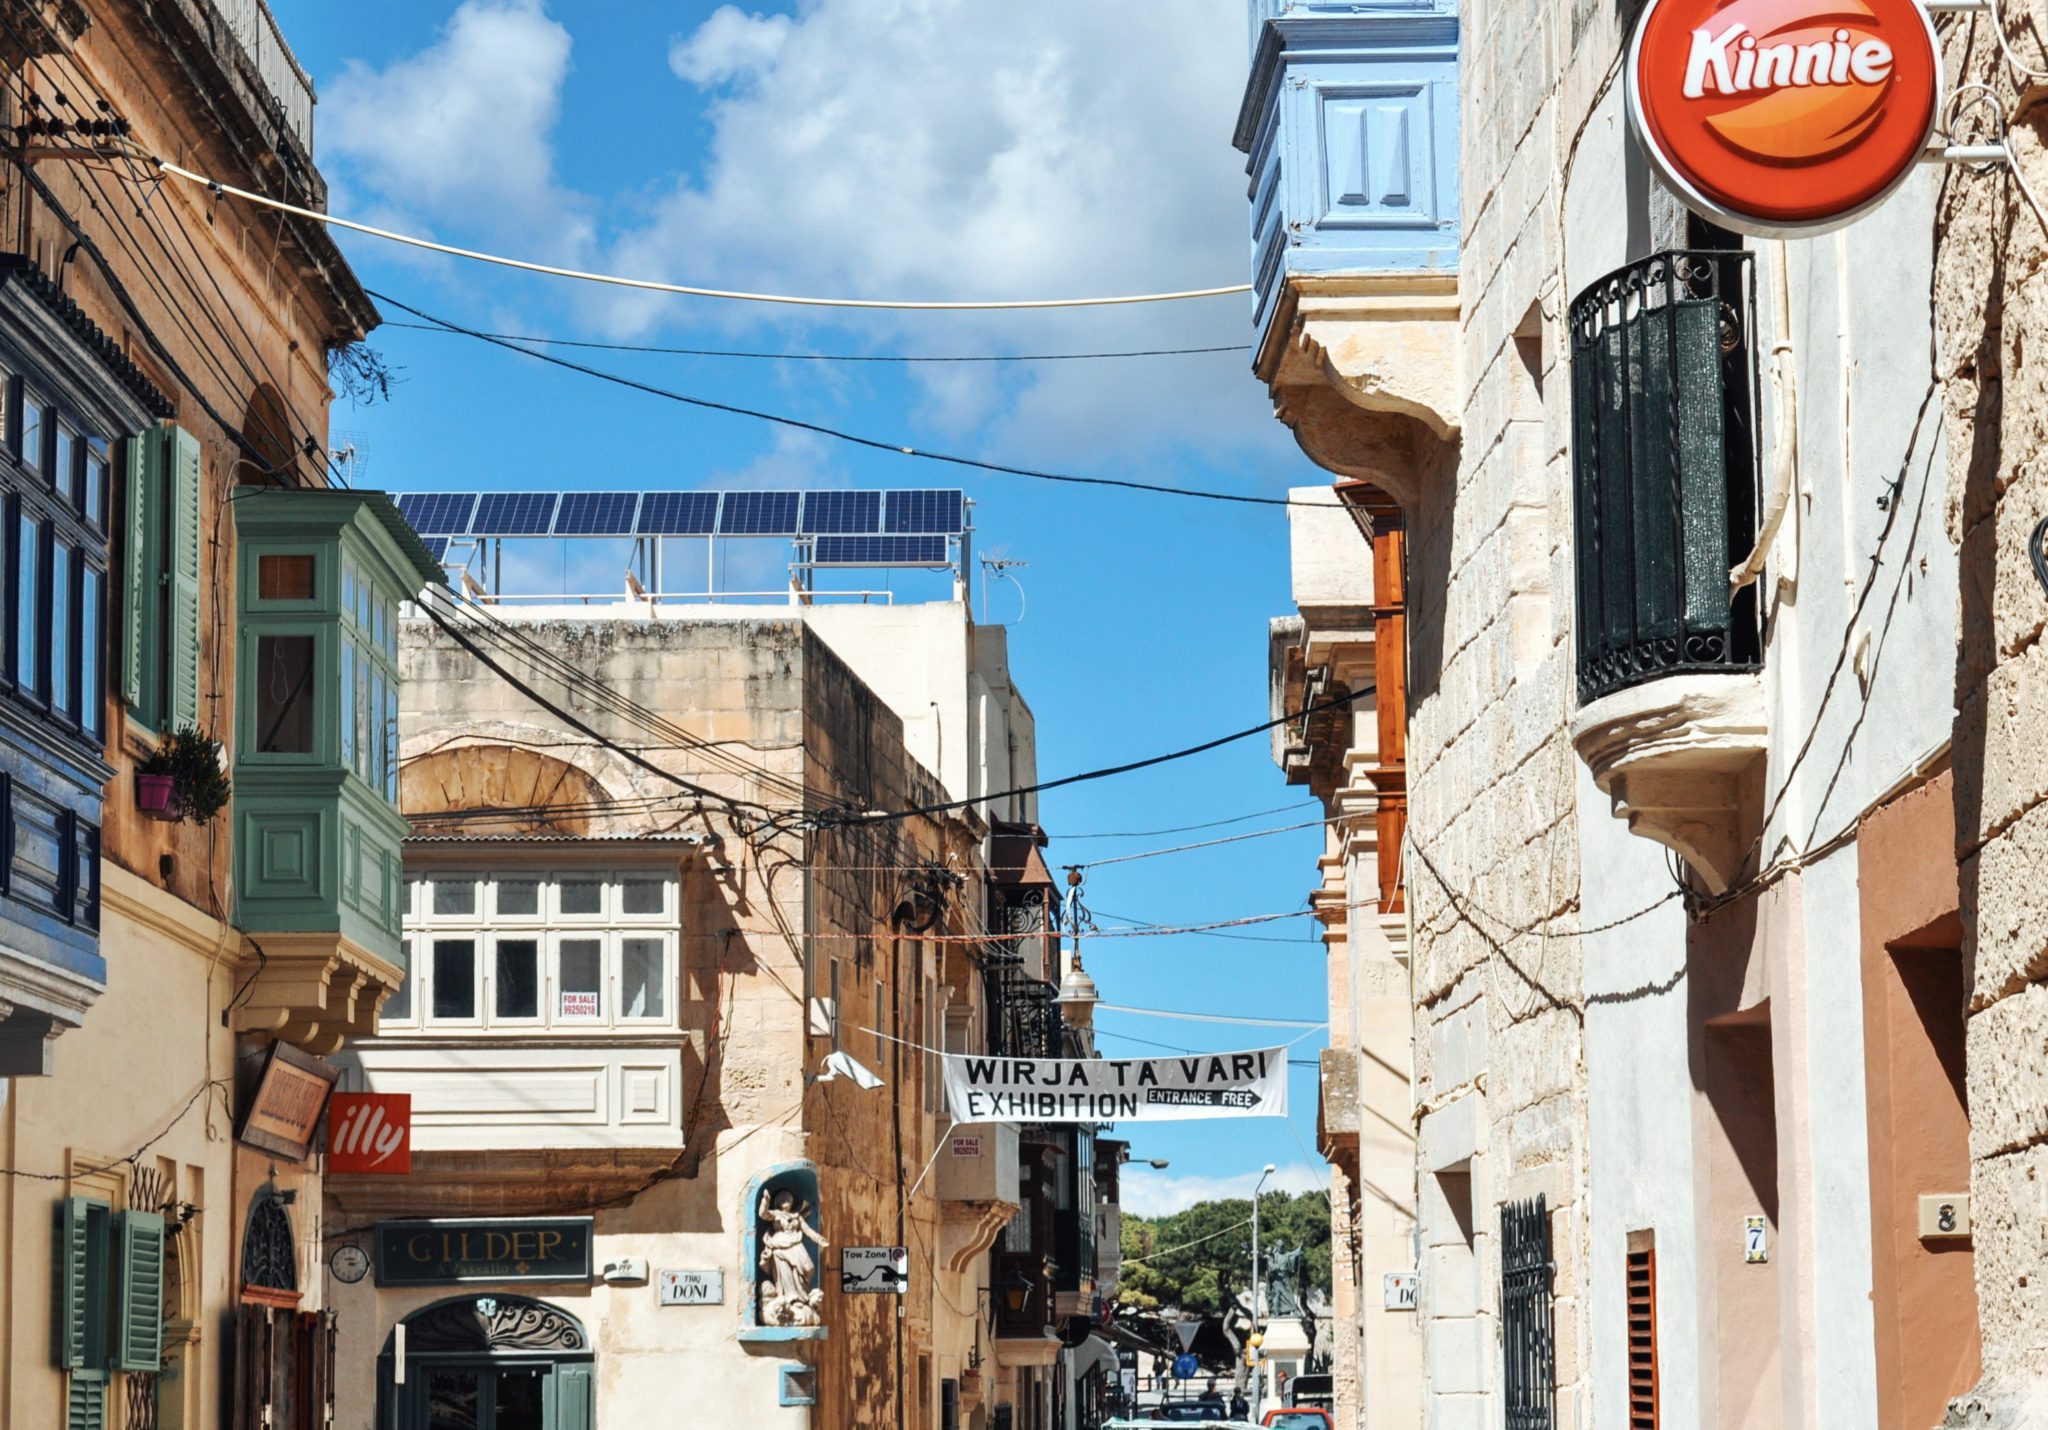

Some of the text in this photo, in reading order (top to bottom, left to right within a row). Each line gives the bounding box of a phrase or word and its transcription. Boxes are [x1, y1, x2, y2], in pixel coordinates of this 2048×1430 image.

[1682, 22, 1894, 99] Kinnie
[563, 994, 595, 1004] FOR SALE
[563, 1004, 595, 1015] 99250218
[965, 1058, 1089, 1087] WIRJA
[1180, 1052, 1266, 1084] VARI
[967, 1091, 1138, 1117] EXHIBITION
[1149, 1090, 1253, 1106] ENTRANCE FREE
[333, 1103, 405, 1167] illy
[1938, 1203, 1956, 1232] 8
[407, 1230, 566, 1262] GILDER
[1749, 1228, 1763, 1250] 7
[844, 1250, 887, 1259] Tow Zone
[684, 1274, 701, 1284] TRIQ
[673, 1284, 708, 1299] DONI
